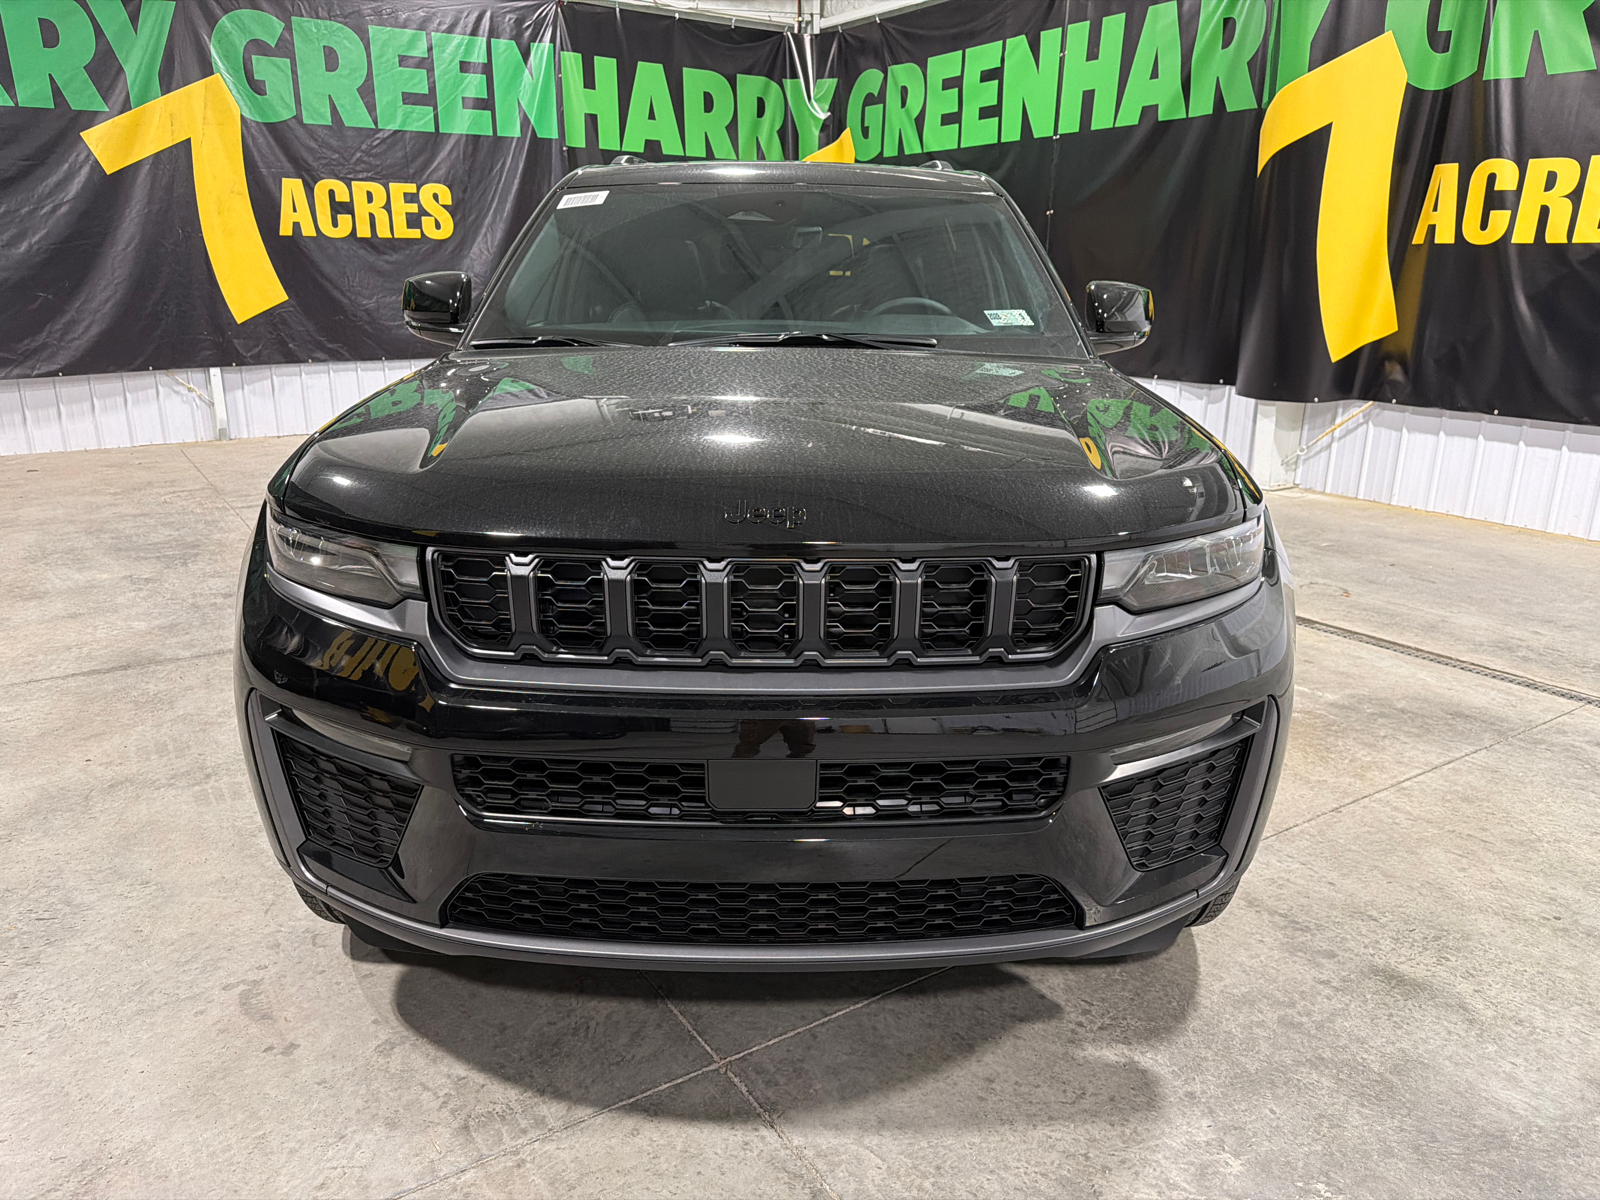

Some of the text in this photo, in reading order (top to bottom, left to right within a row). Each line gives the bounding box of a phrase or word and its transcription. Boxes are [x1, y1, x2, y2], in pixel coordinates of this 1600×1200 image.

[0, 0, 559, 140] RY GREEN
[561, 26, 1062, 161] HARRY GREEN
[80, 73, 455, 324] 7 ACRES
[1257, 30, 1408, 363] 7
[724, 500, 807, 529] Jeep
